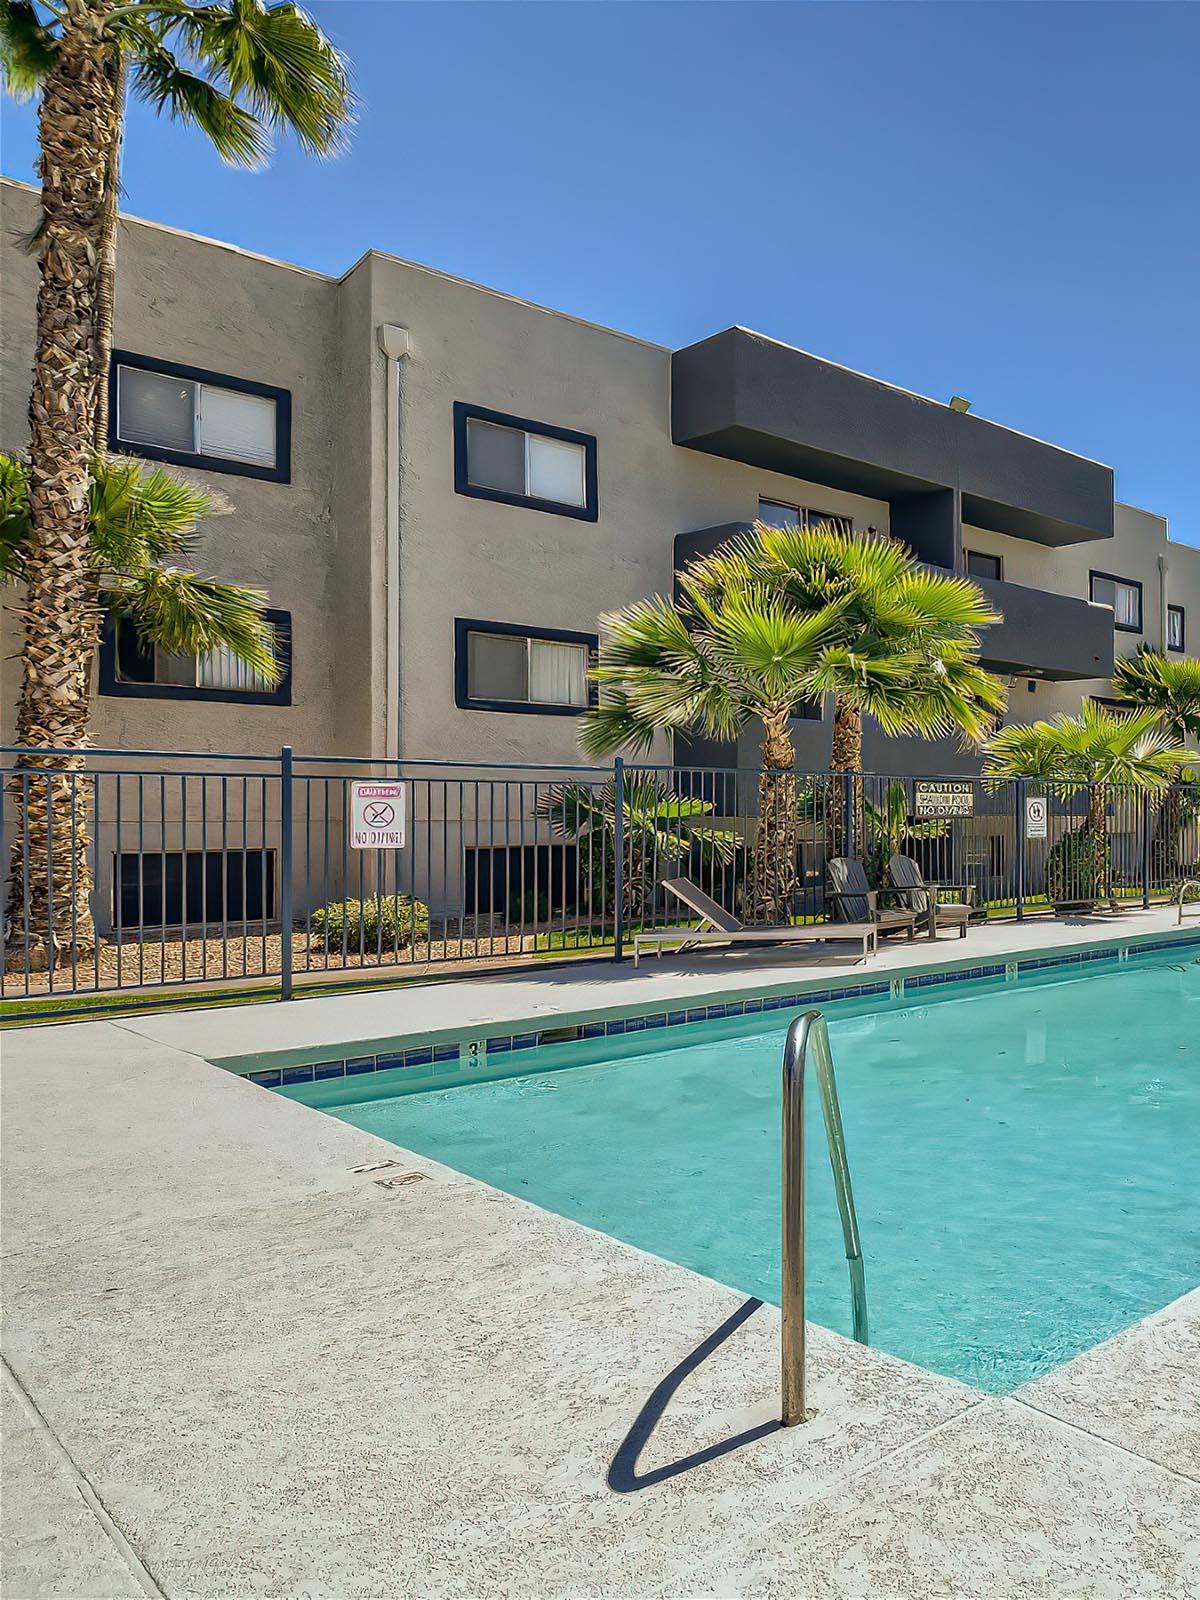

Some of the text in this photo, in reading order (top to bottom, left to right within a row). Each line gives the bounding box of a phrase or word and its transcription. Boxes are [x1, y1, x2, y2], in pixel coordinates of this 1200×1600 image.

[919, 783, 969, 793] CAUTION
[919, 806, 935, 815] NO
[355, 831, 367, 844] NO
